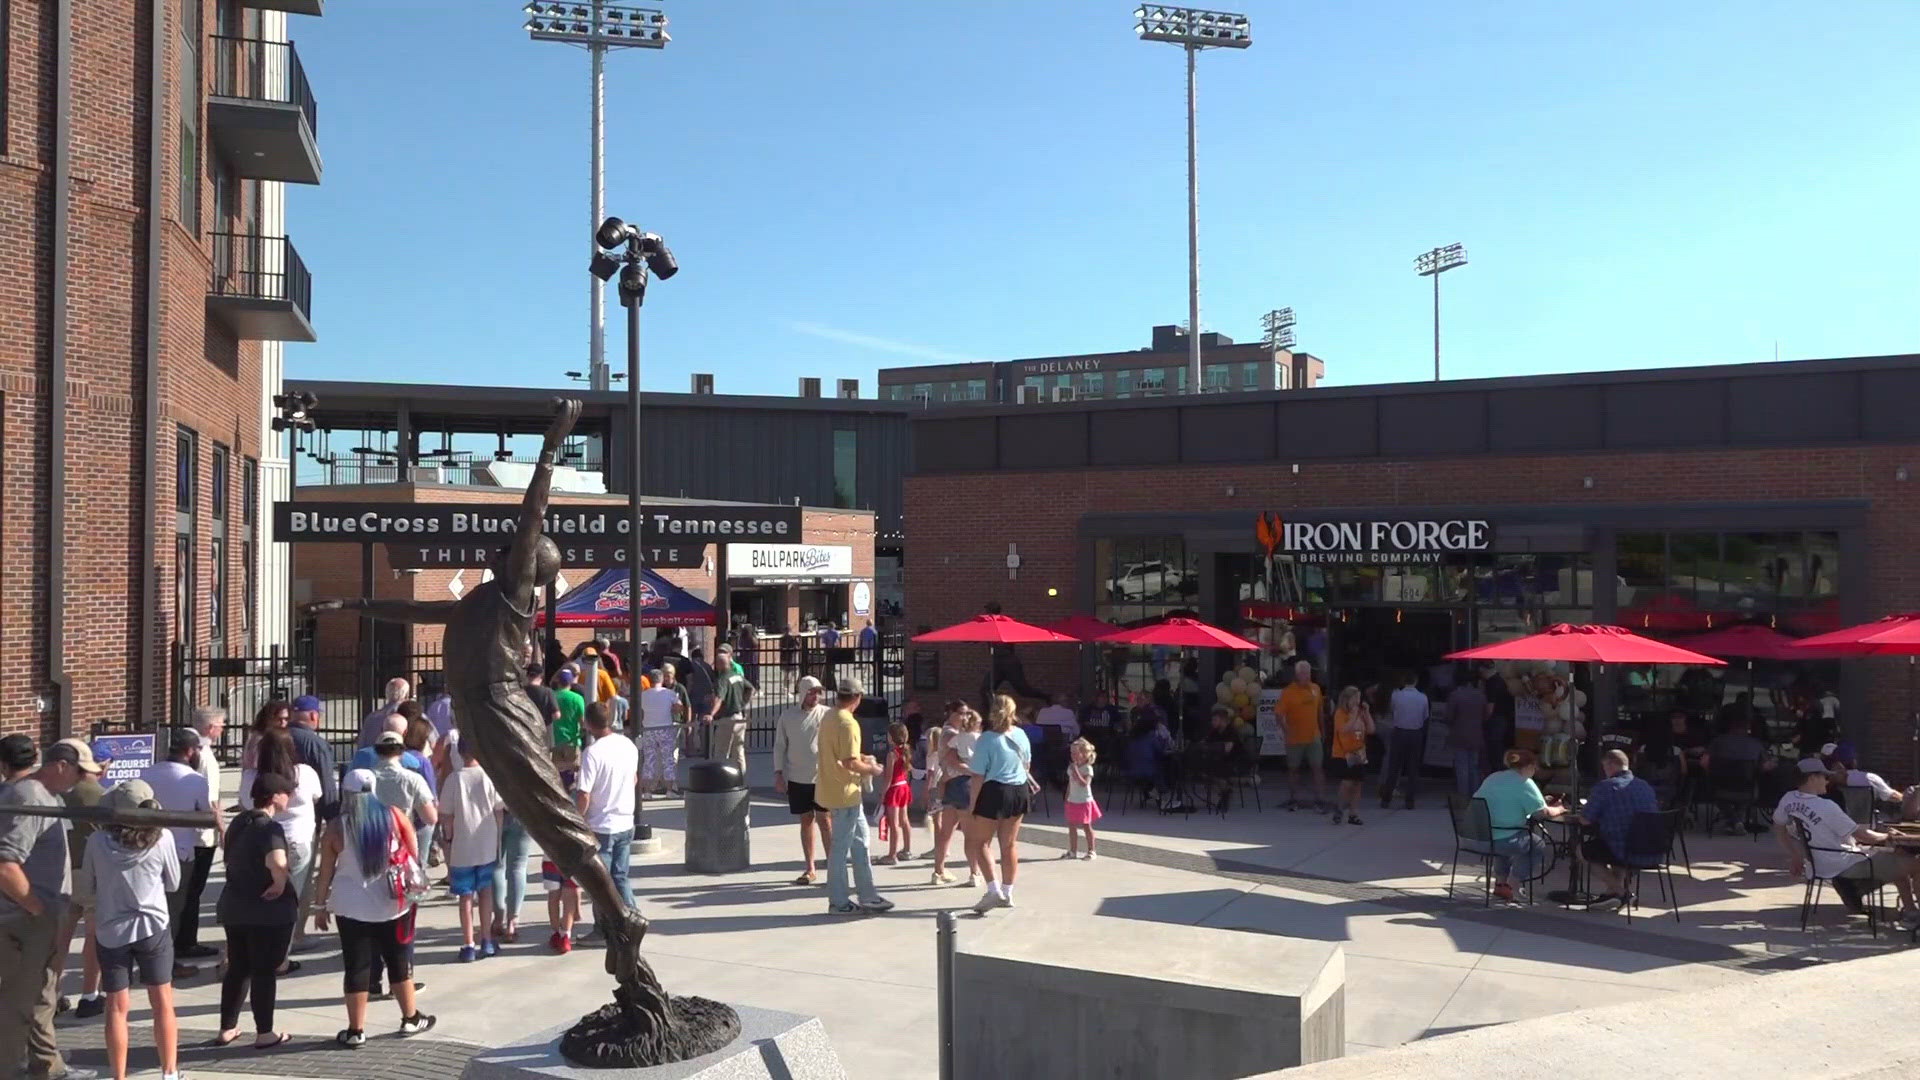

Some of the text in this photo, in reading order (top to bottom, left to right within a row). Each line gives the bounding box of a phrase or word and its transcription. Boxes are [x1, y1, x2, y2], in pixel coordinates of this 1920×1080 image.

[1040, 360, 1100, 372] DELANEY
[290, 512, 440, 532] BlueCross
[617, 515, 644, 534] o
[654, 515, 788, 534] Tennessee
[1283, 520, 1490, 551] IRON FORGE
[420, 548, 502, 562] THIR
[752, 547, 831, 571] BALLPARK Bites
[1300, 552, 1441, 563] BREWING COMPANY
[107, 769, 141, 779] CLOSED
